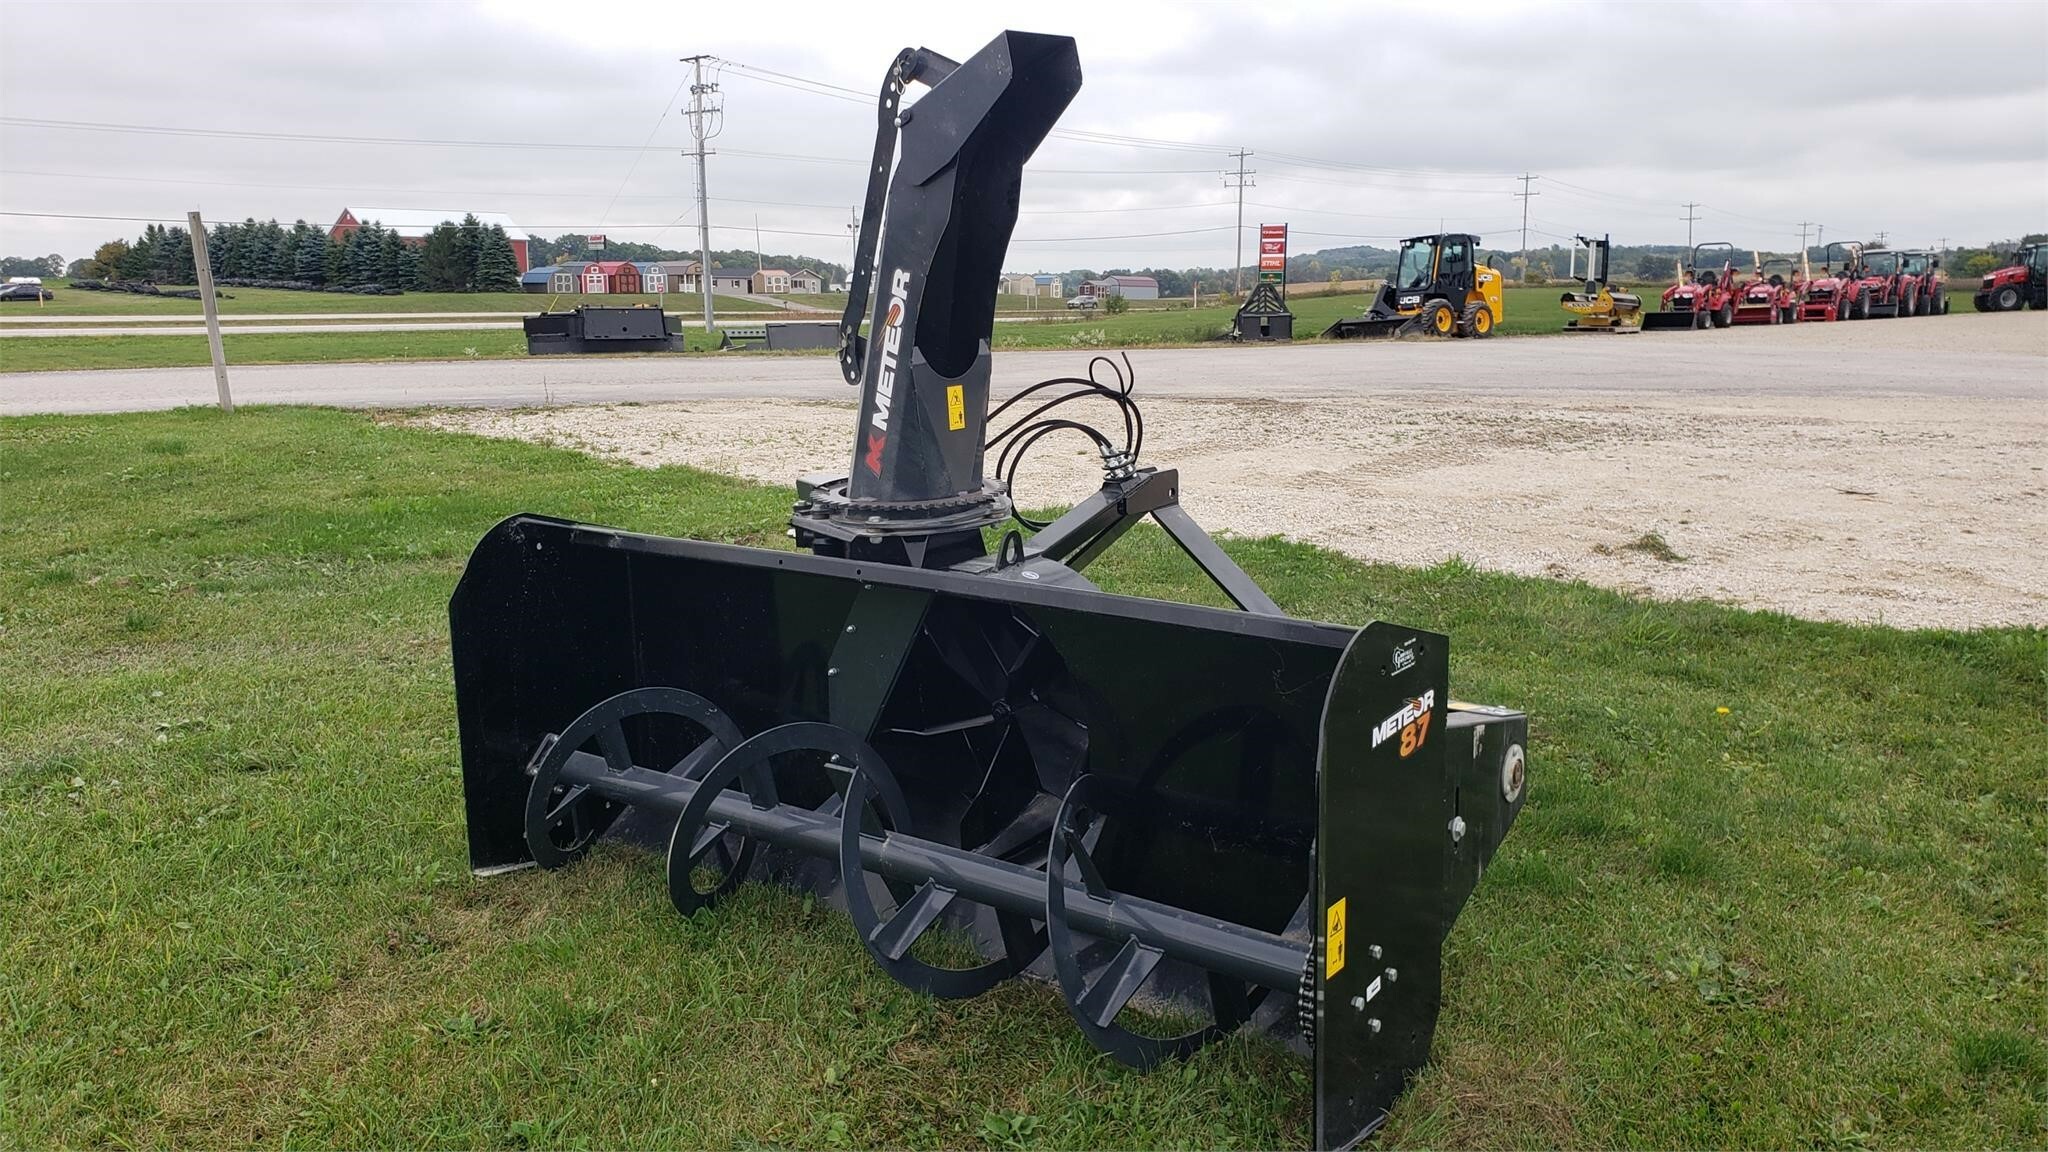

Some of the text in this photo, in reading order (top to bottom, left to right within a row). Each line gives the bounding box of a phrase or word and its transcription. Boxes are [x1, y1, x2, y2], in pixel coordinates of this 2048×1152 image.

[1399, 295, 1420, 304] JCB
[872, 268, 910, 432] METEOR
[1372, 689, 1434, 748] METEOR
[1400, 710, 1431, 757] 87
